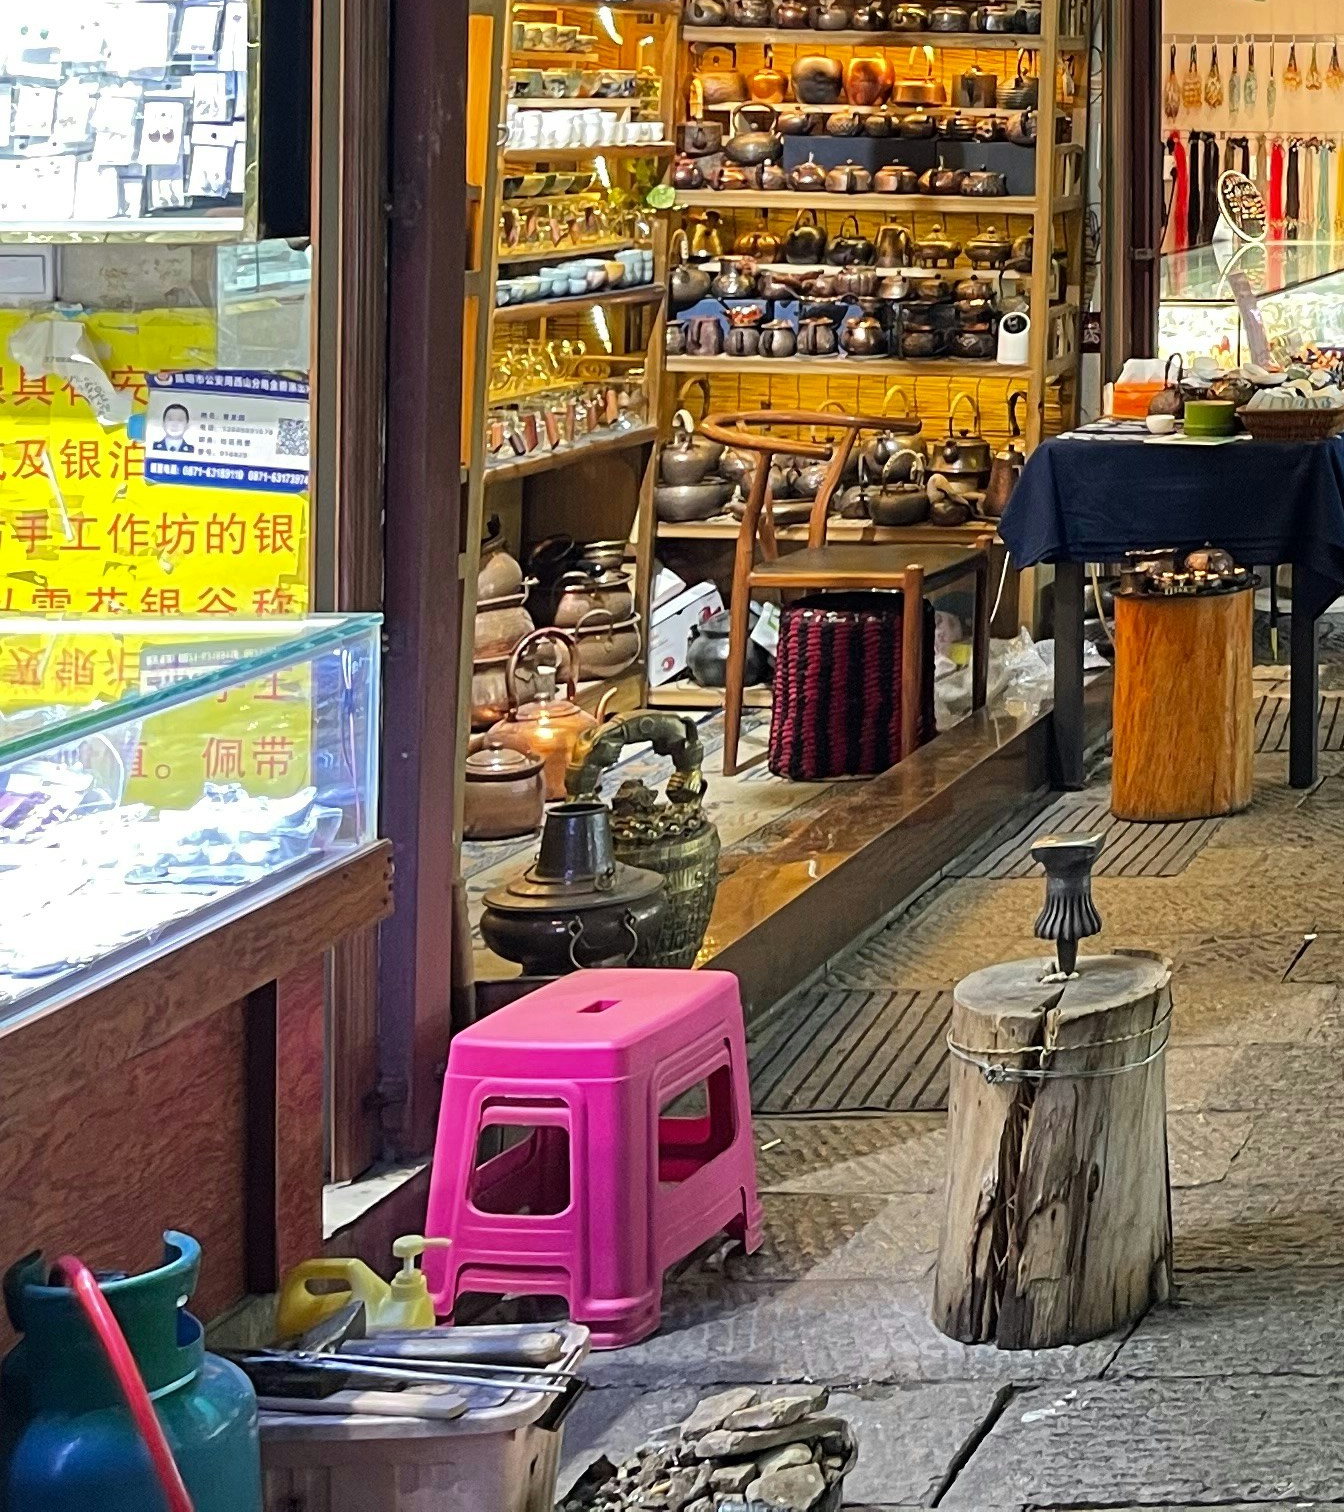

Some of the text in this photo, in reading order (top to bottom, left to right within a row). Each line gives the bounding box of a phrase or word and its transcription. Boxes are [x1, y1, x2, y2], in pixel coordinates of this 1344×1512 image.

[0, 438, 146, 481] 及银泊
[0, 511, 294, 555] 手工作坊的银
